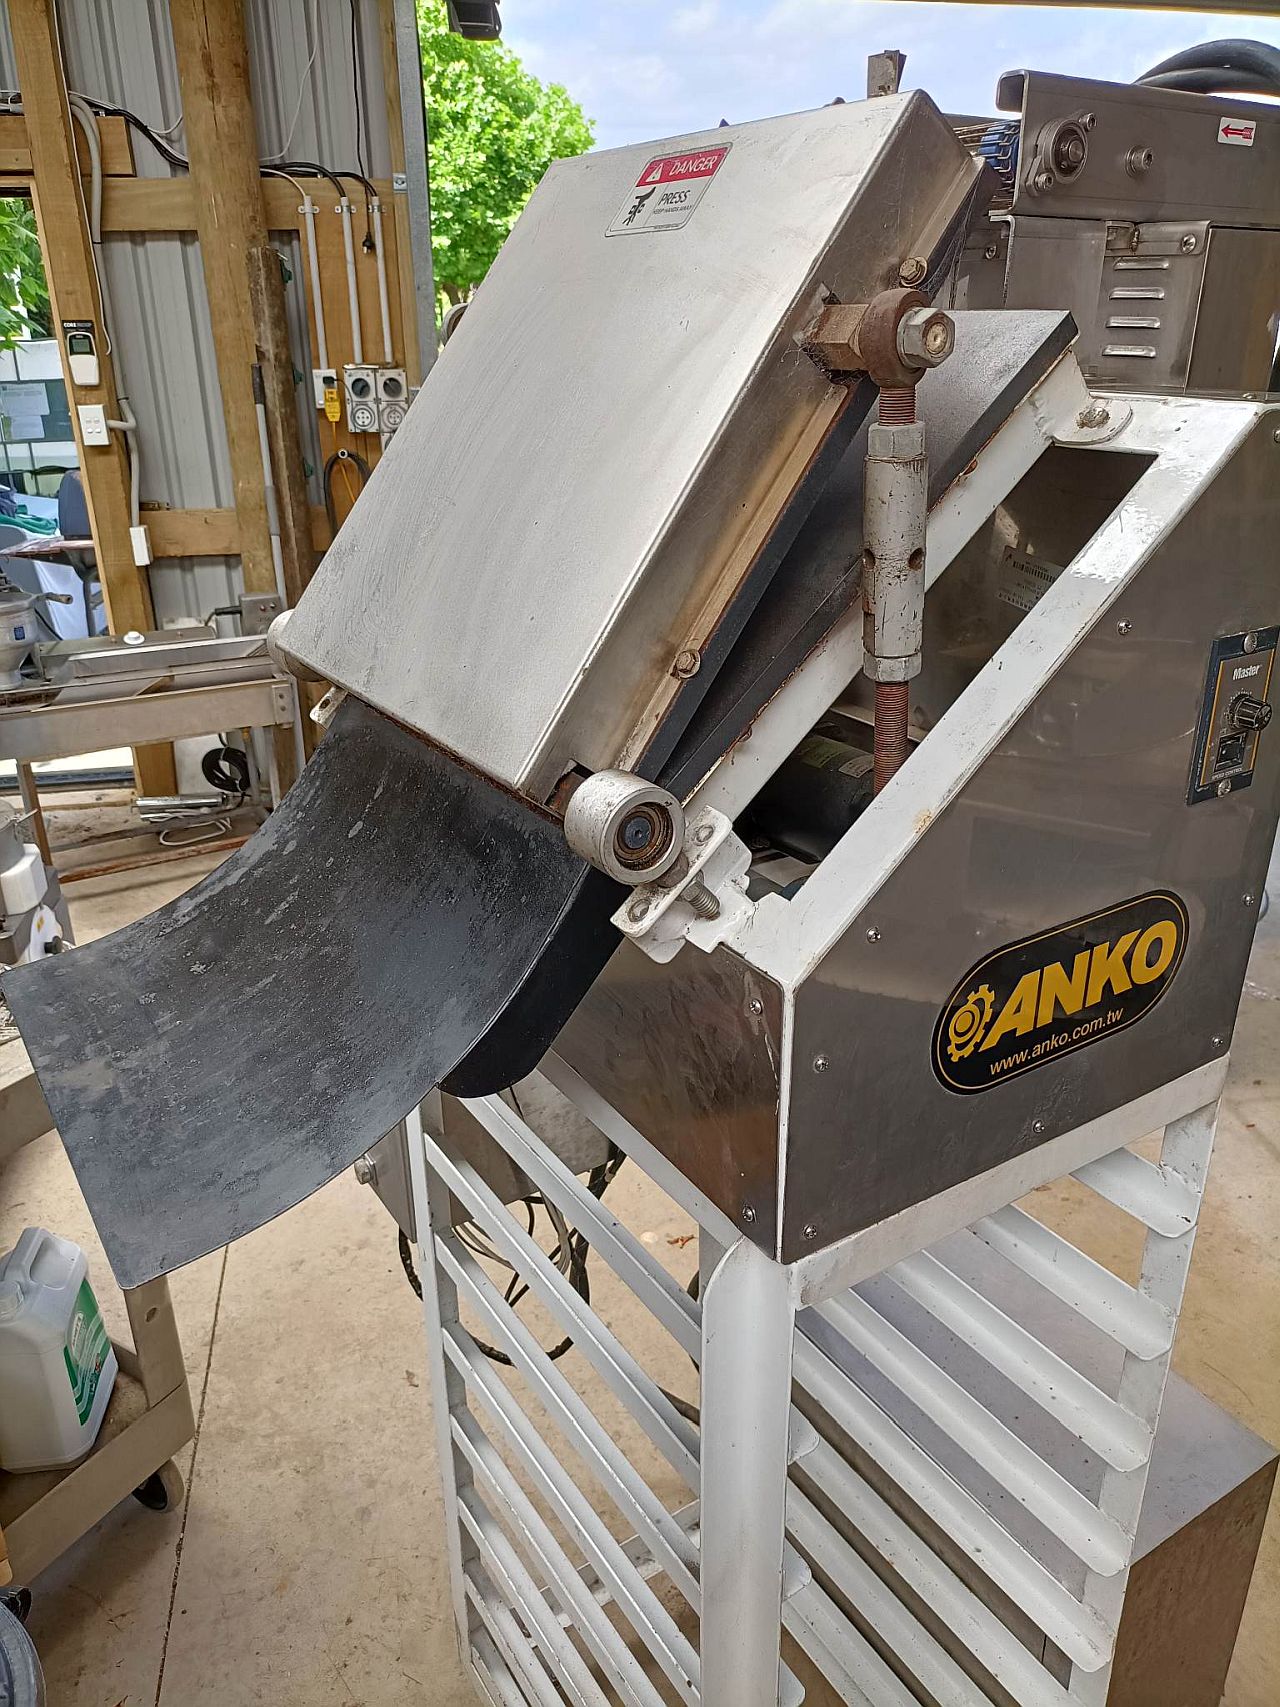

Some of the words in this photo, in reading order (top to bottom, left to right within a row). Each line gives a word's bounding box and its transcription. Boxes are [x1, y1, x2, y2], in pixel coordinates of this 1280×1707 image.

[669, 155, 718, 176] DANGER
[658, 190, 691, 206] PRESS
[1232, 665, 1260, 681] Master
[979, 920, 1177, 1052] ANKO
[989, 1008, 1124, 1075] www.anko.com.tw
